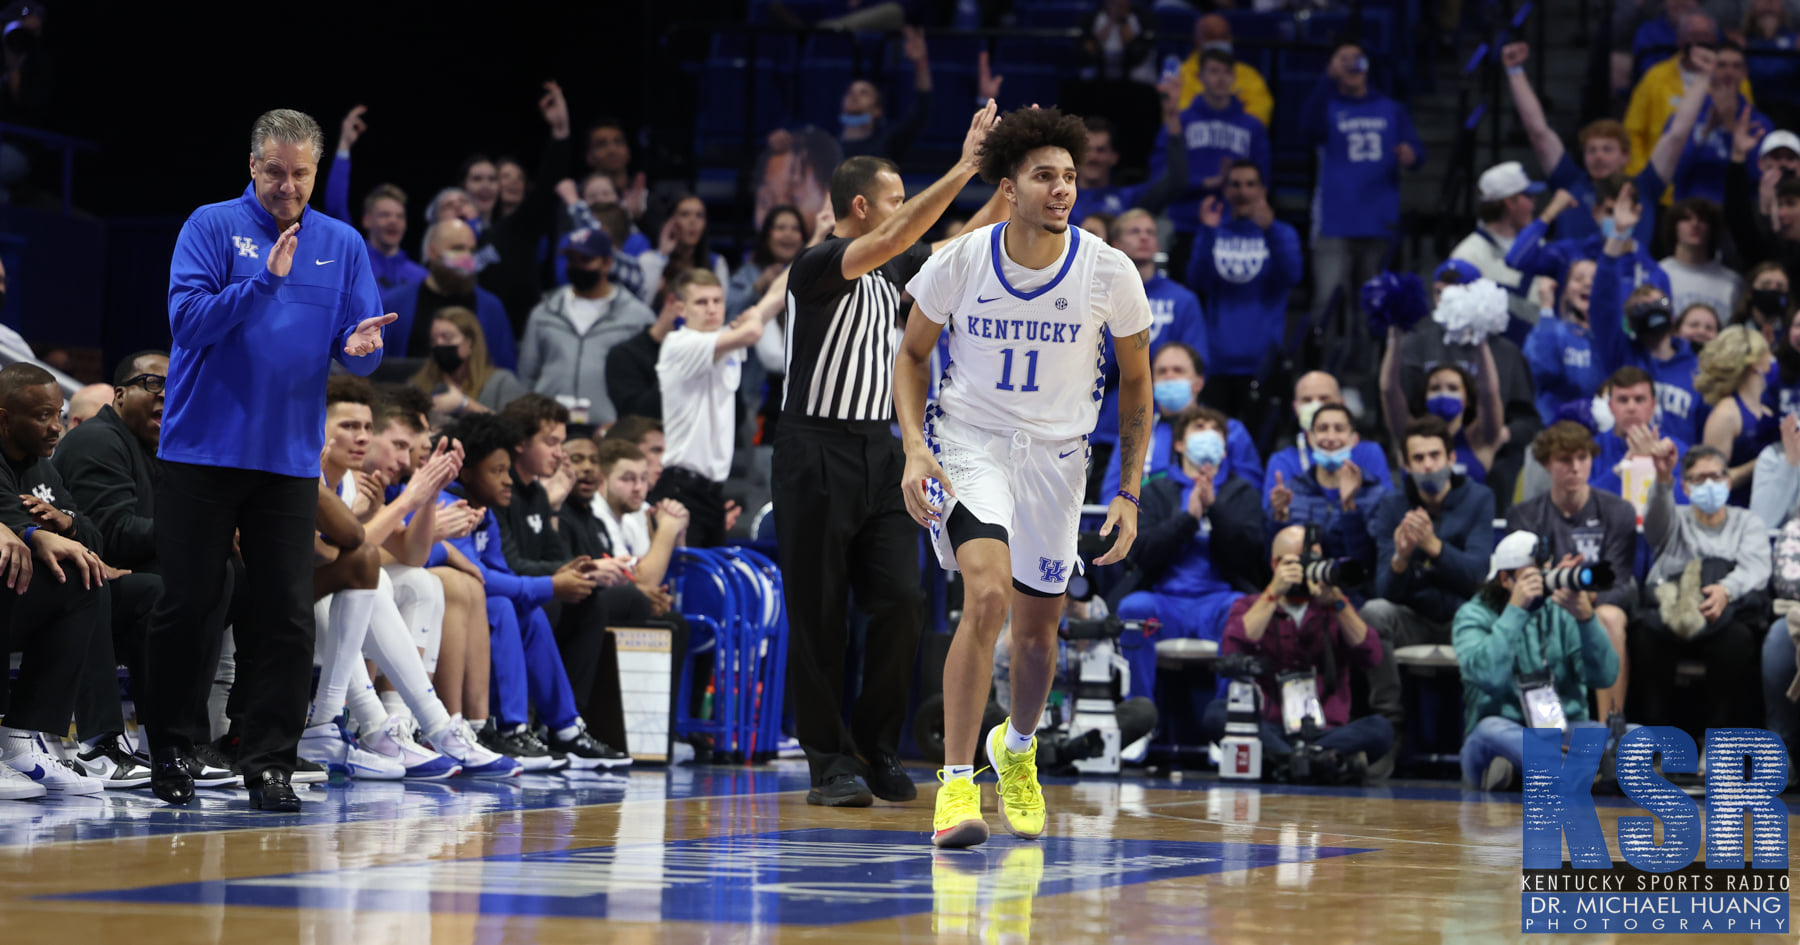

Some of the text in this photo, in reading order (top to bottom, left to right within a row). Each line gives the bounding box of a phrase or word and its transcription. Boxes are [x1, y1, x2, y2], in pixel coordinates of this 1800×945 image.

[1348, 132, 1382, 162] 23
[232, 235, 259, 259] UK
[967, 315, 1081, 343] KENTUCKY
[996, 348, 1039, 392] 11
[1039, 556, 1067, 583] UK
